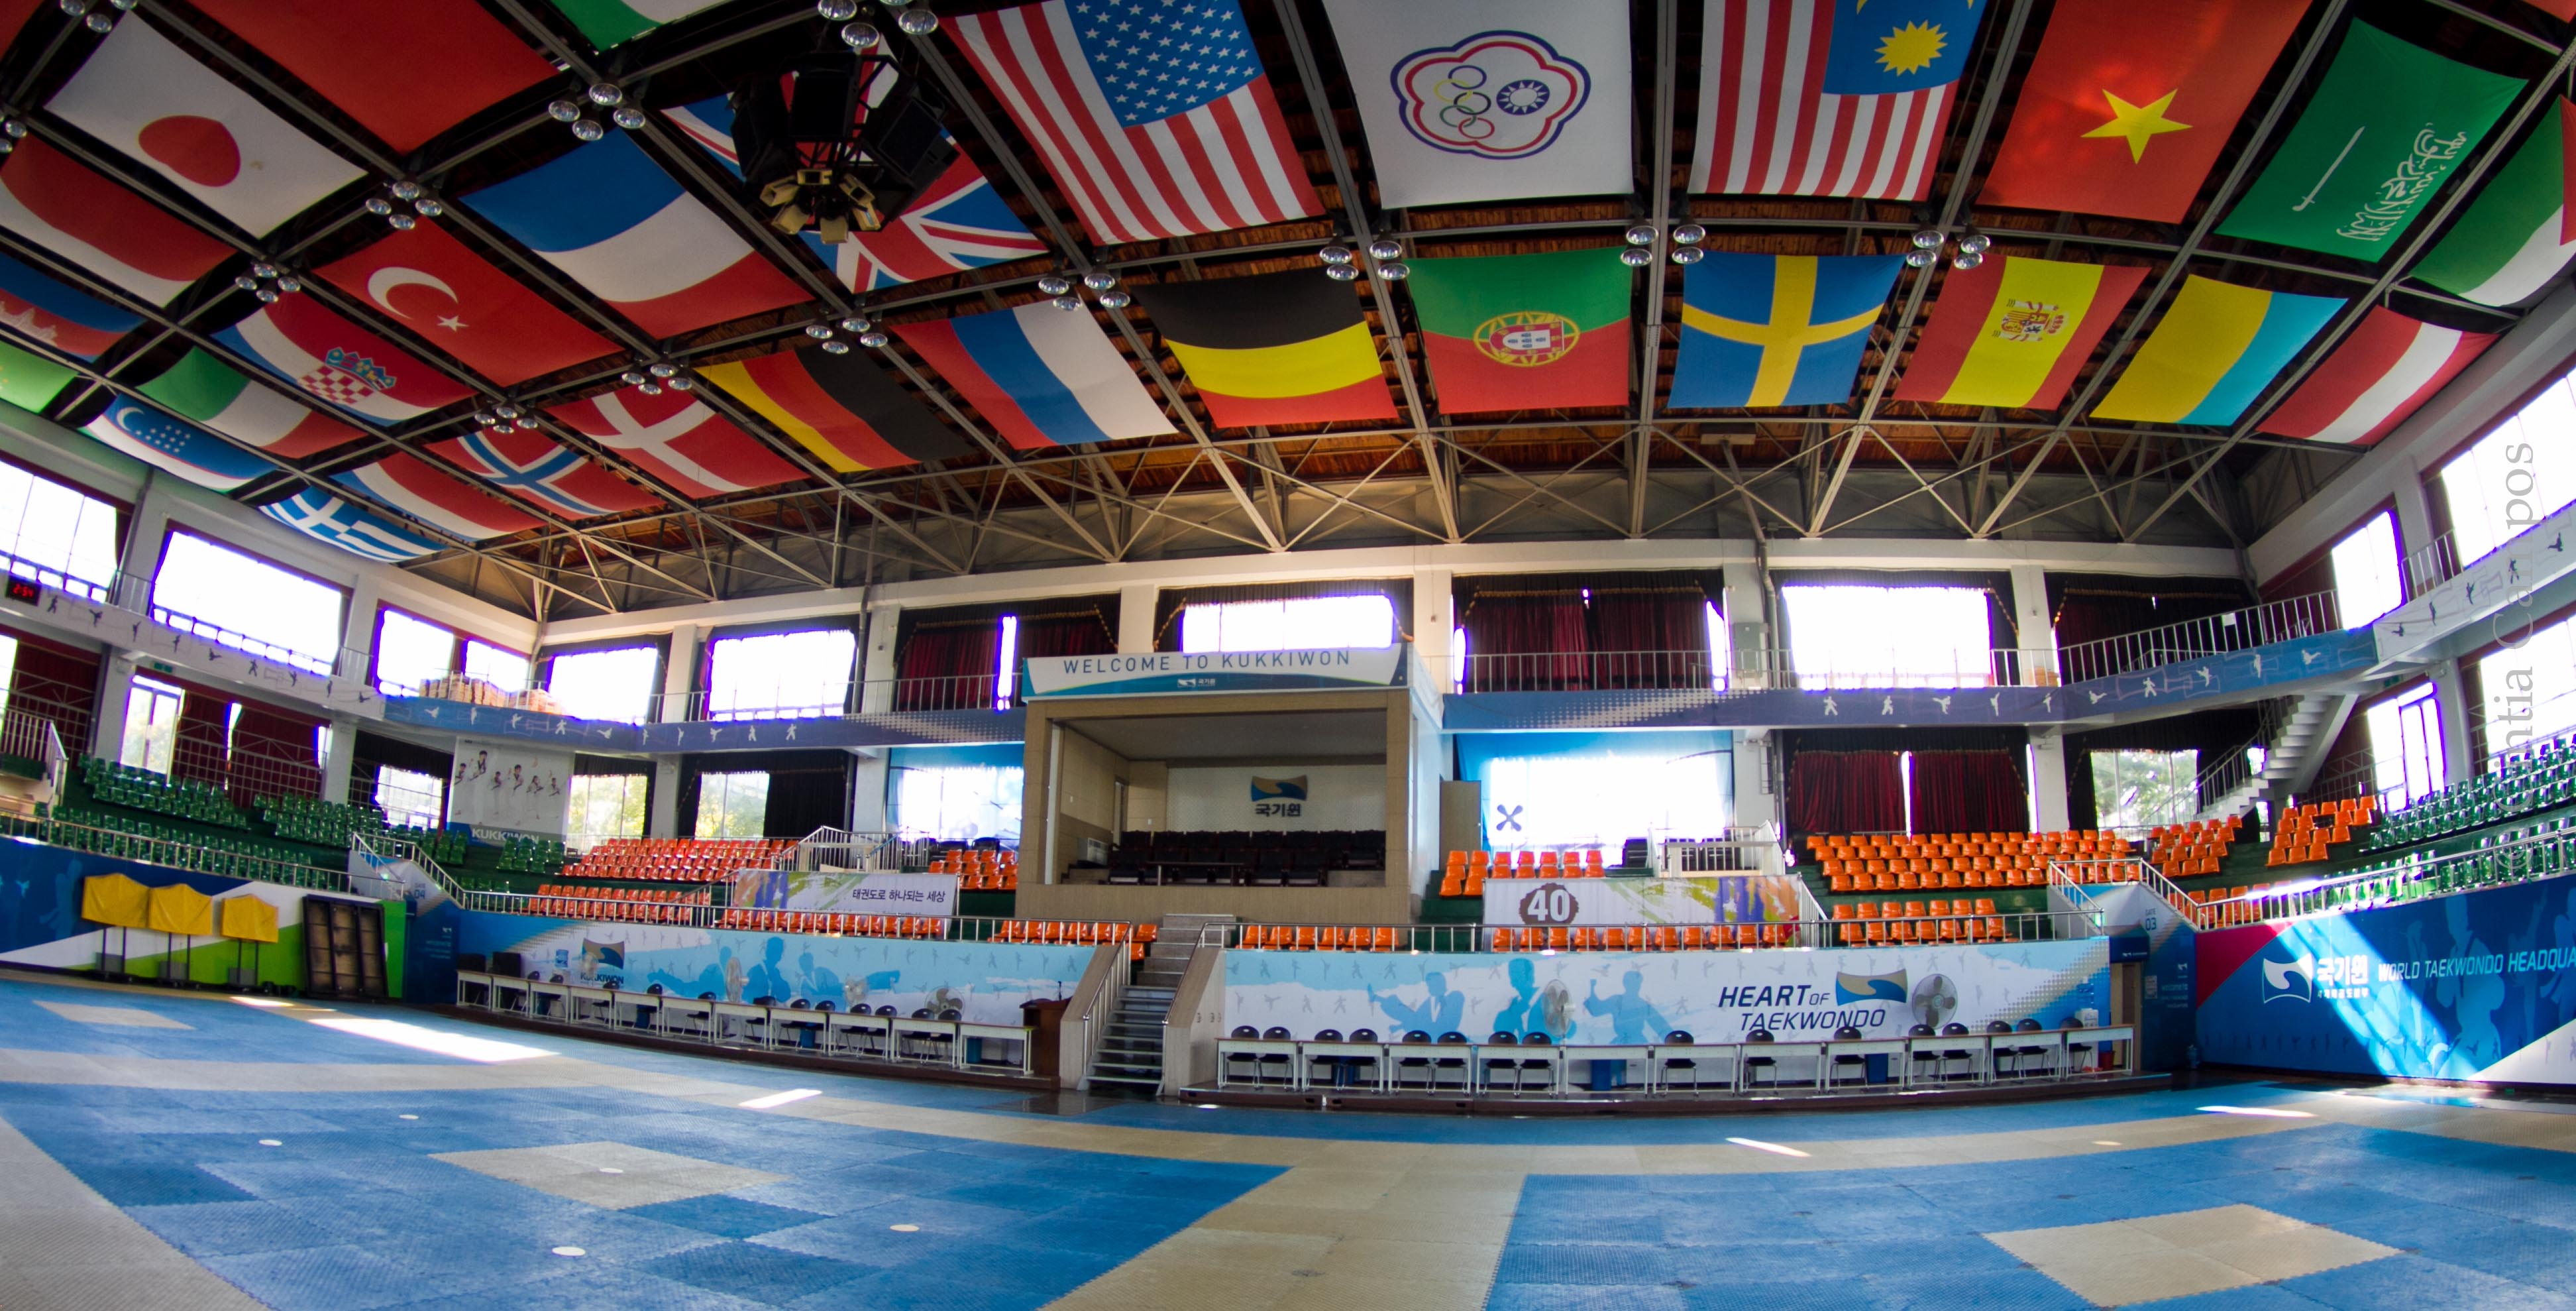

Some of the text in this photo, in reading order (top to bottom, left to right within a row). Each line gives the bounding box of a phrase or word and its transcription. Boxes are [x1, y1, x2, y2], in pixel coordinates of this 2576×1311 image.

[1063, 650, 1350, 673] WELCOME TO KUKKIWON
[1256, 803, 1301, 817] 국기원
[852, 889, 946, 903] 태권도로 하나되는 세상
[1527, 889, 1570, 922] 40
[2145, 918, 2157, 931] 03
[2317, 954, 2368, 986] 국기원
[2379, 961, 2420, 982] WORLD
[2424, 954, 2504, 978] TAEKWONDO
[1718, 985, 1831, 1007] HEART OF
[1741, 1009, 1886, 1031] TAEKWONDO
